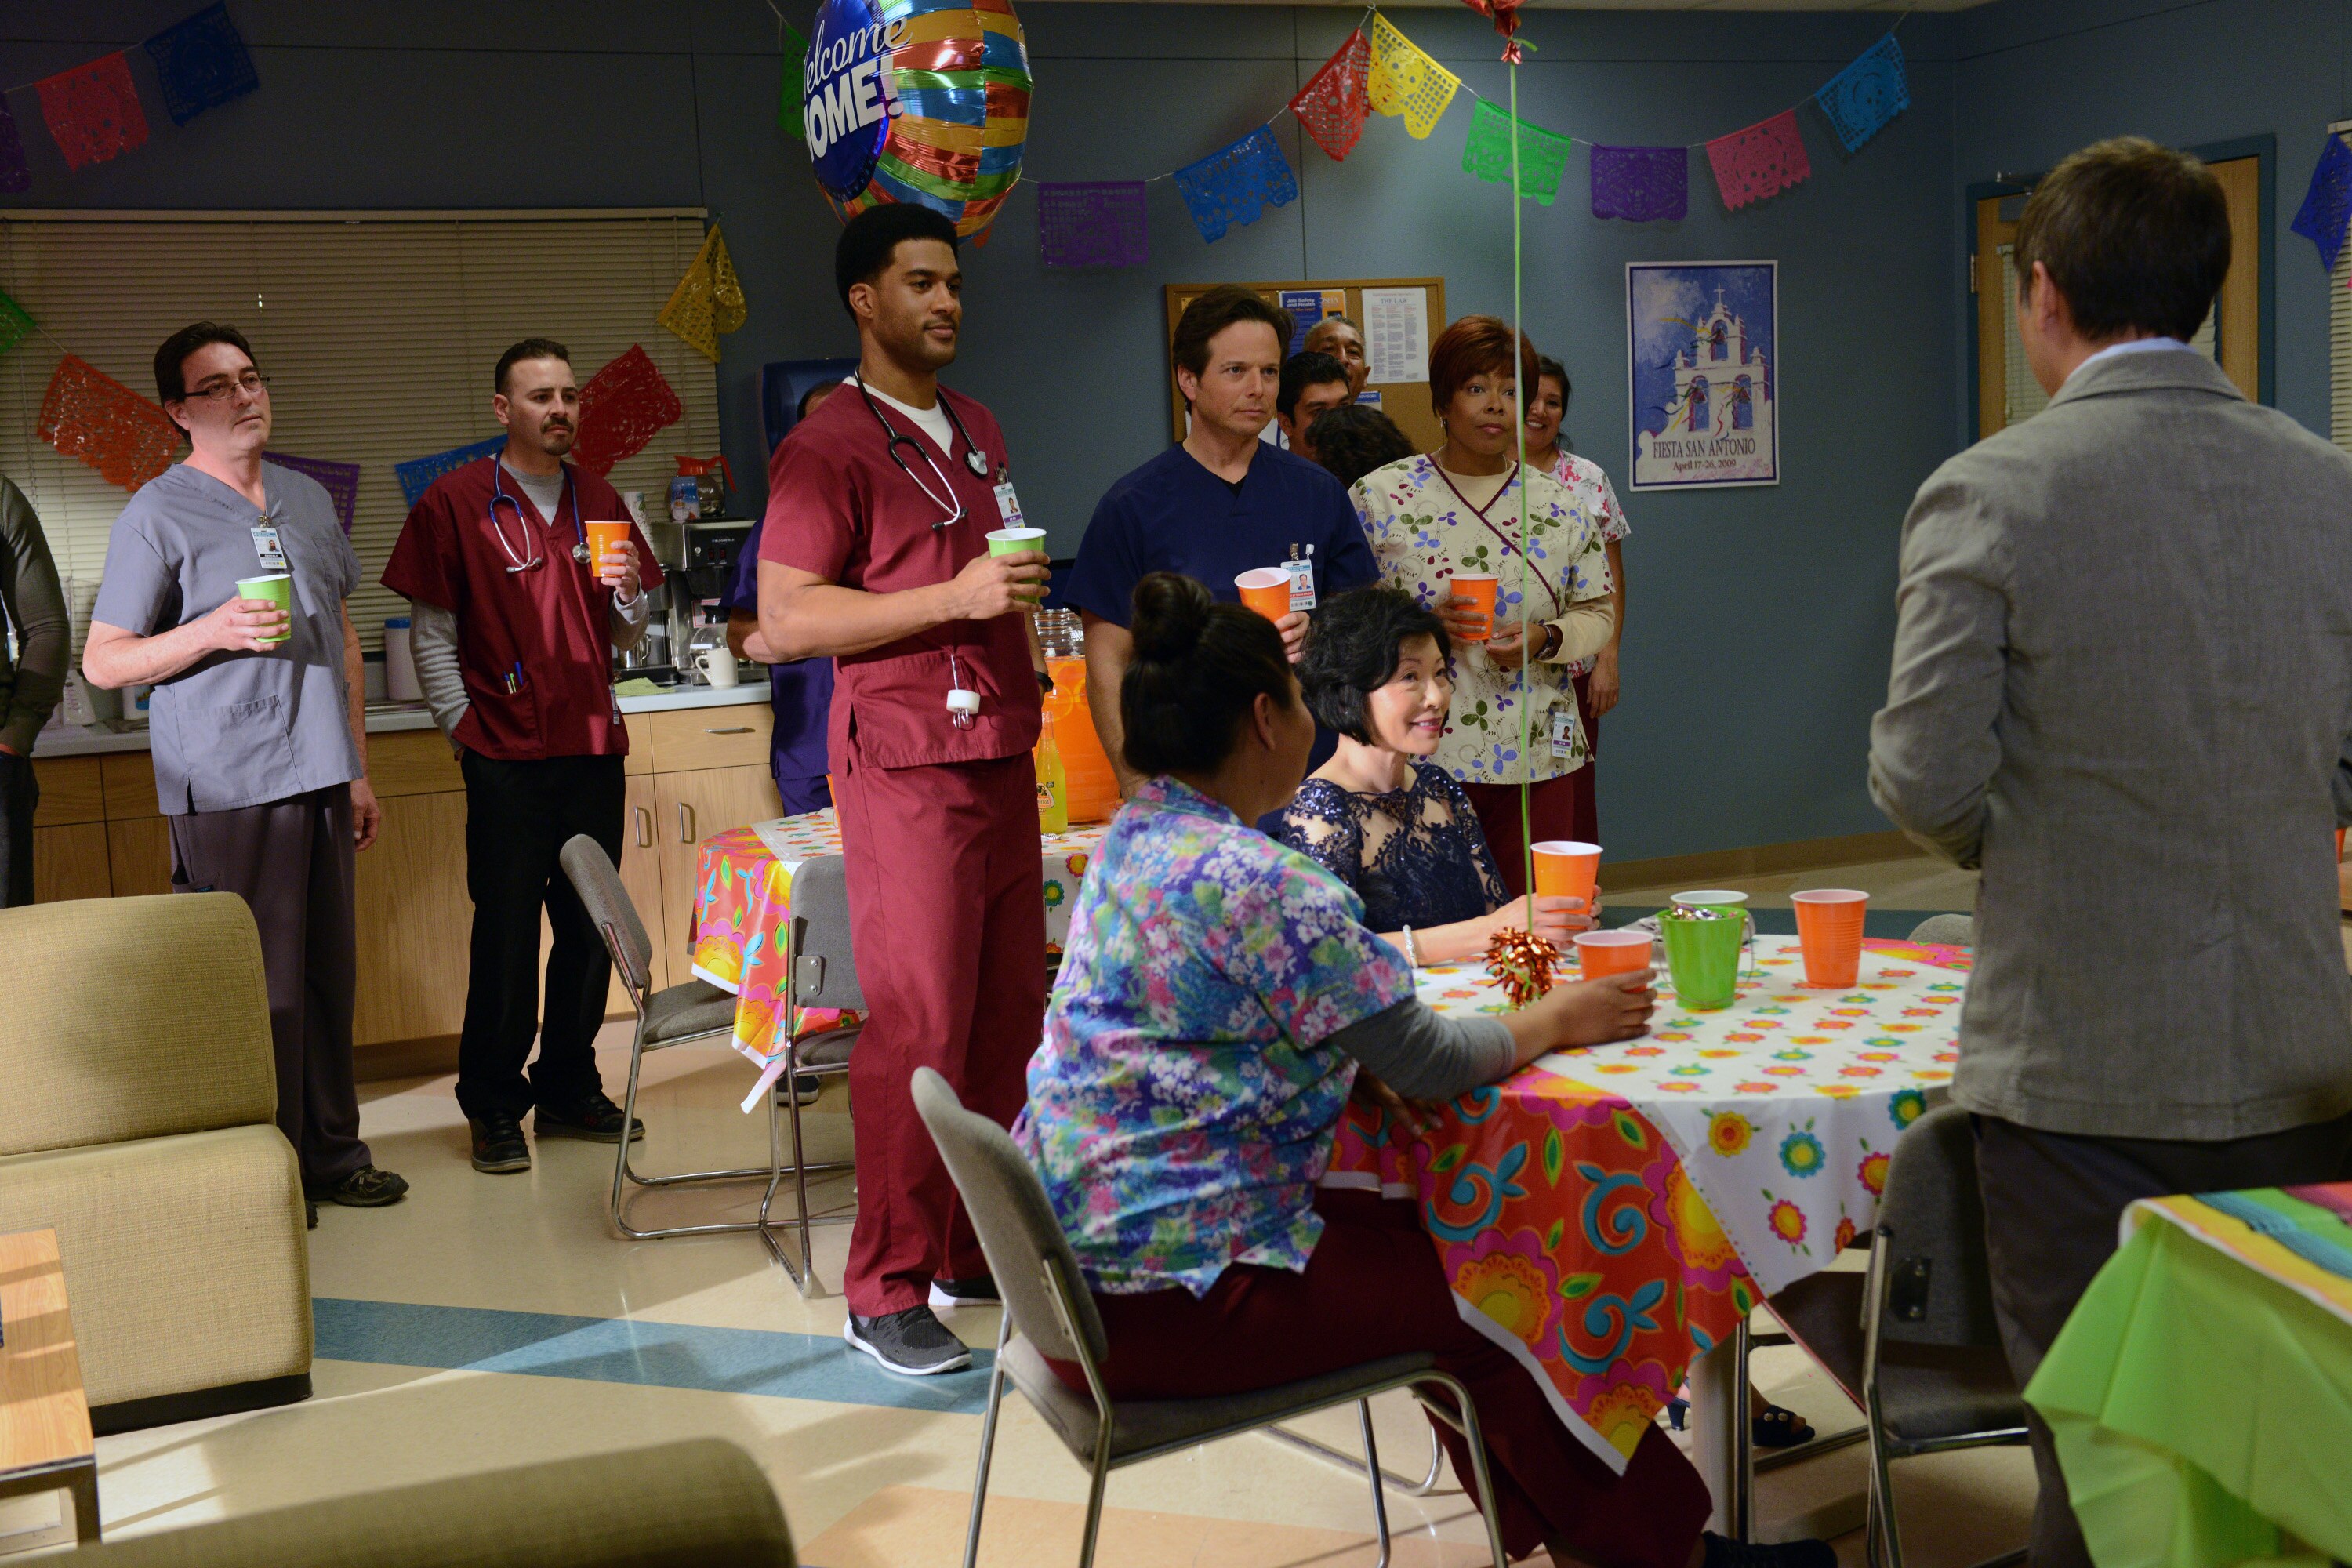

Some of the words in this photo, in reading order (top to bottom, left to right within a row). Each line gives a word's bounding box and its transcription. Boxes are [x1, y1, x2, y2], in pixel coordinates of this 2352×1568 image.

[804, 16, 913, 100] elcome
[1653, 441, 1683, 458] FIESTA
[1686, 440, 1705, 457] SAN
[1709, 438, 1755, 456] ANTONIO
[1673, 460, 1693, 472] April
[1694, 460, 1716, 469] 17-26,
[1719, 459, 1736, 468] 2009
